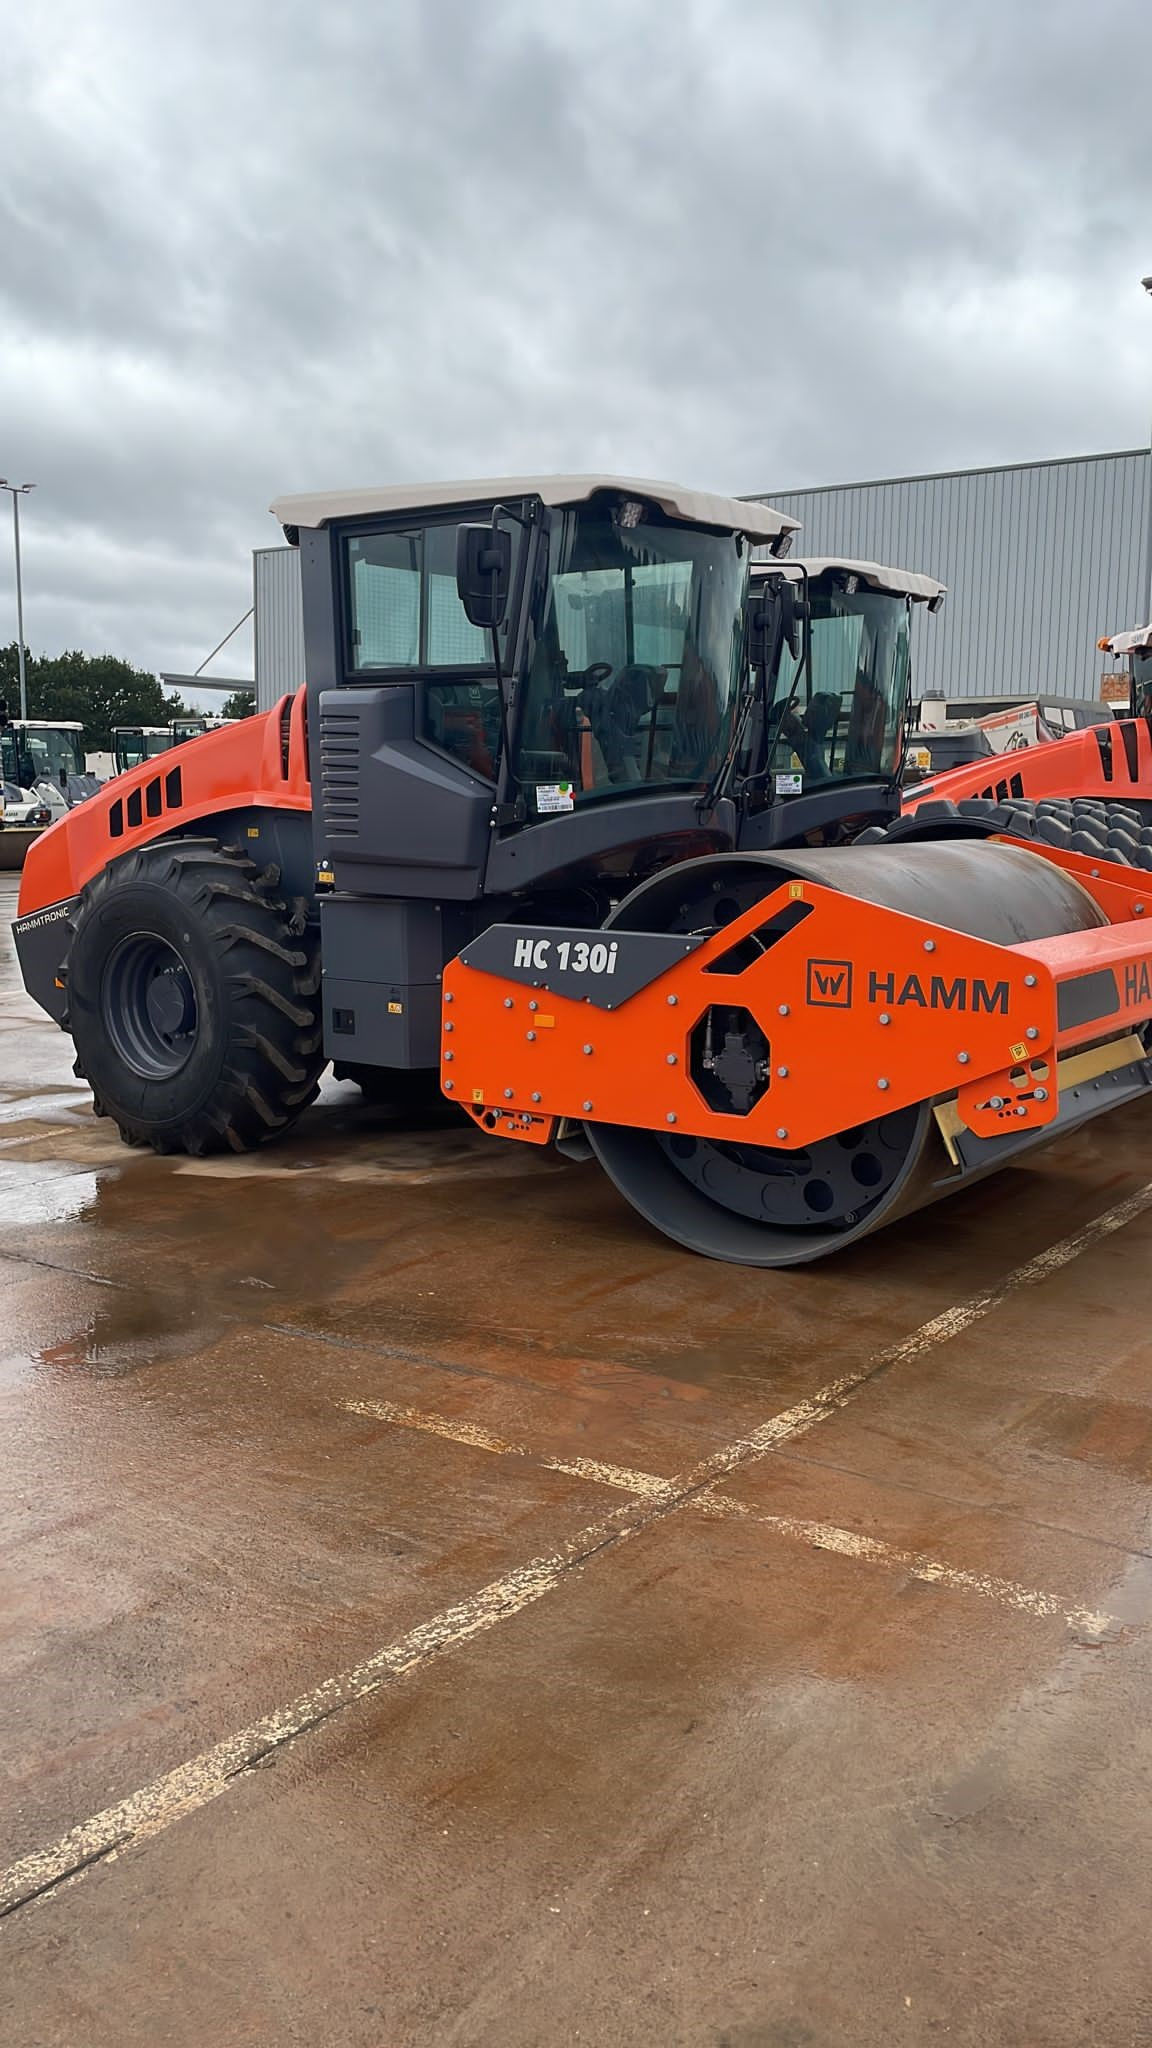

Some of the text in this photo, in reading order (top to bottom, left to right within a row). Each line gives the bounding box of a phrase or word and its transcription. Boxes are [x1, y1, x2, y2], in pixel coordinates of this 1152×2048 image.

[16, 906, 70, 935] HAMMTRONIC
[513, 939, 618, 974] HC 130i
[867, 971, 1010, 1015] HAMM
